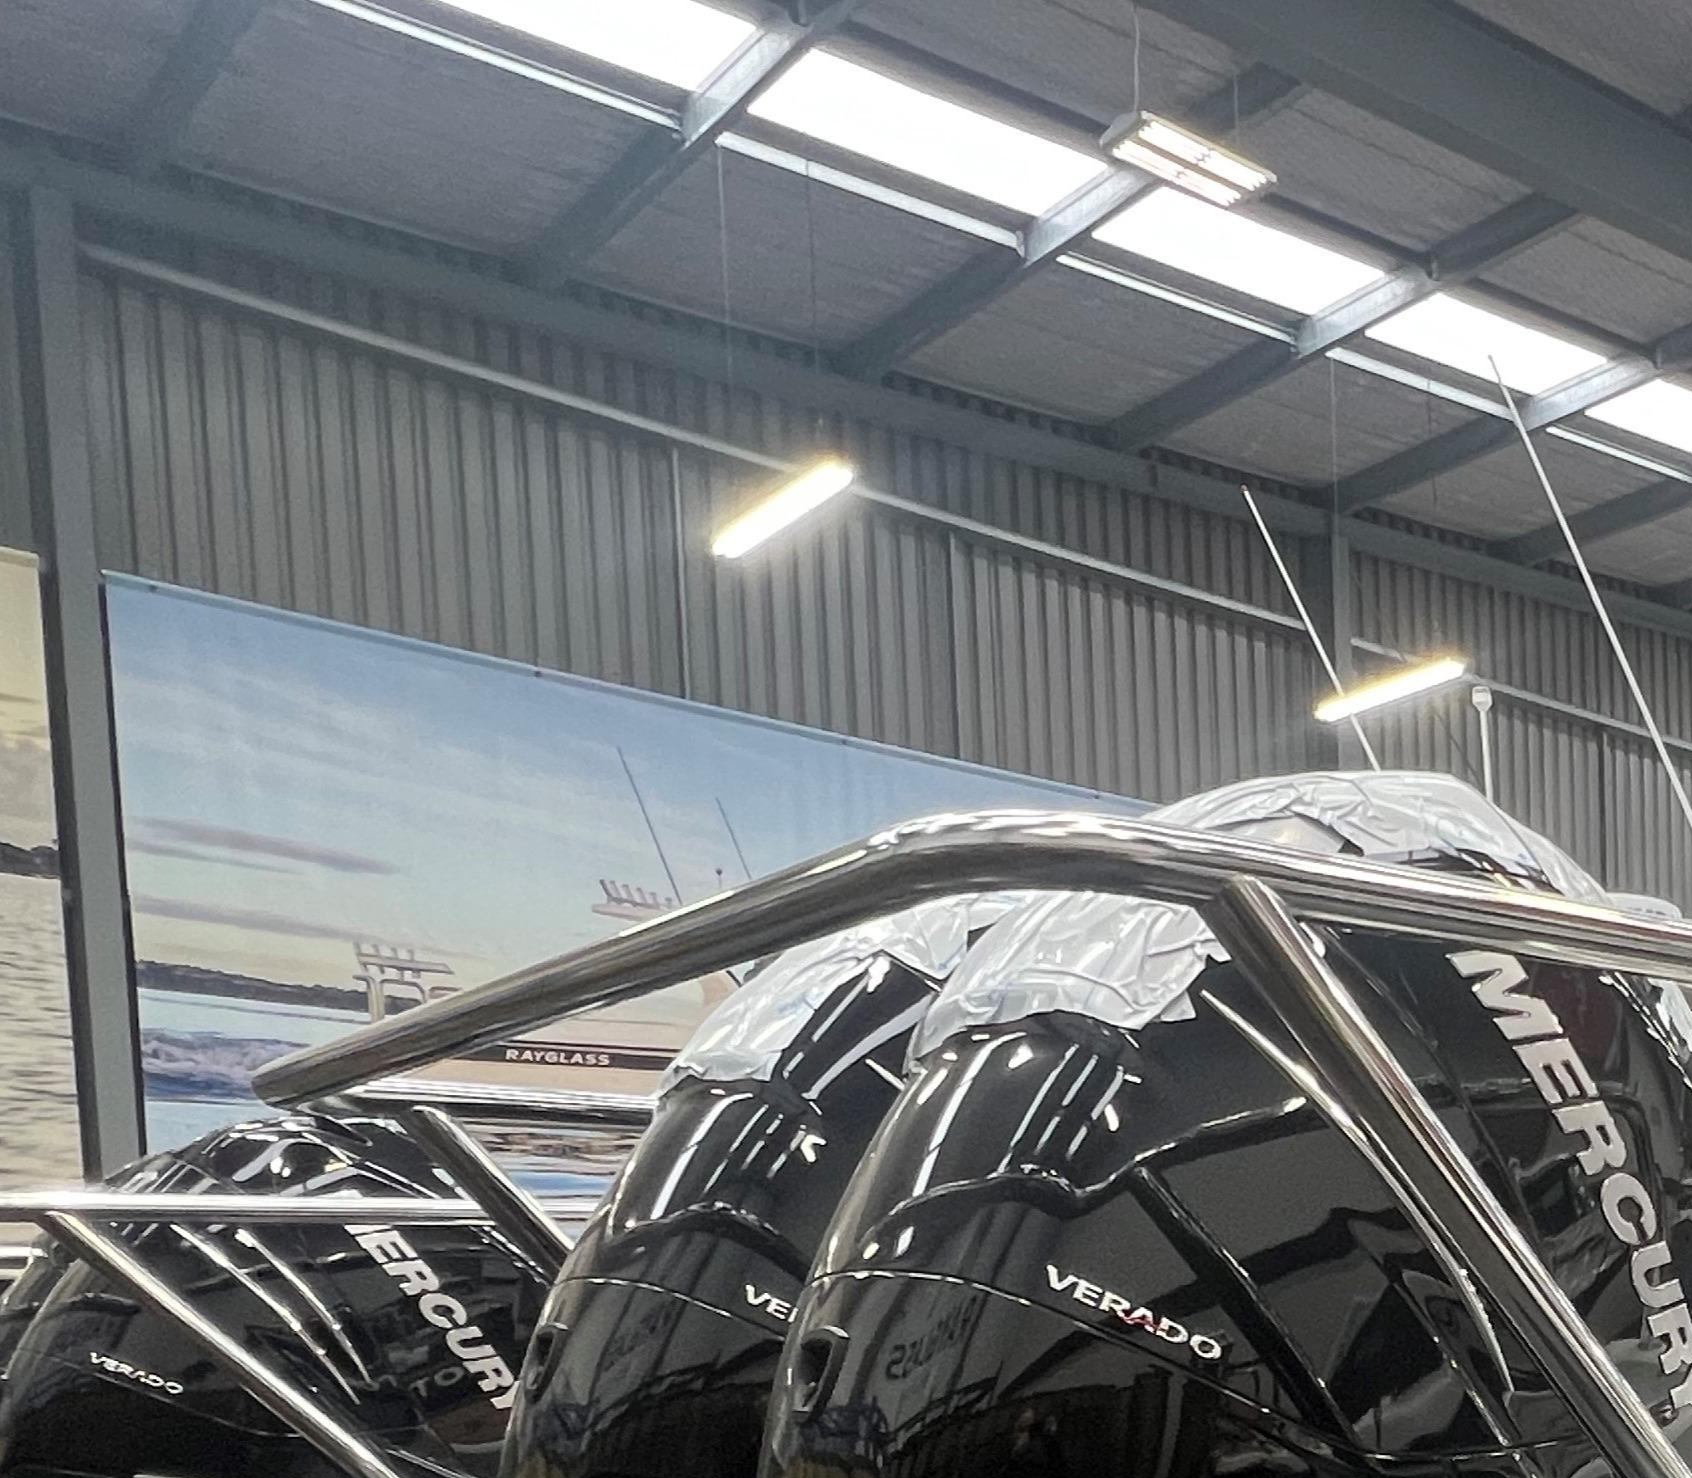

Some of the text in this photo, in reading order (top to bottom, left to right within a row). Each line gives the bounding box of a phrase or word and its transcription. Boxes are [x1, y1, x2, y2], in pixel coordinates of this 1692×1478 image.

[505, 1048, 610, 1066] RAYGLASS
[745, 1284, 799, 1323] VE
[1046, 1264, 1222, 1360] VERADO
[90, 1352, 184, 1394] VERADO
